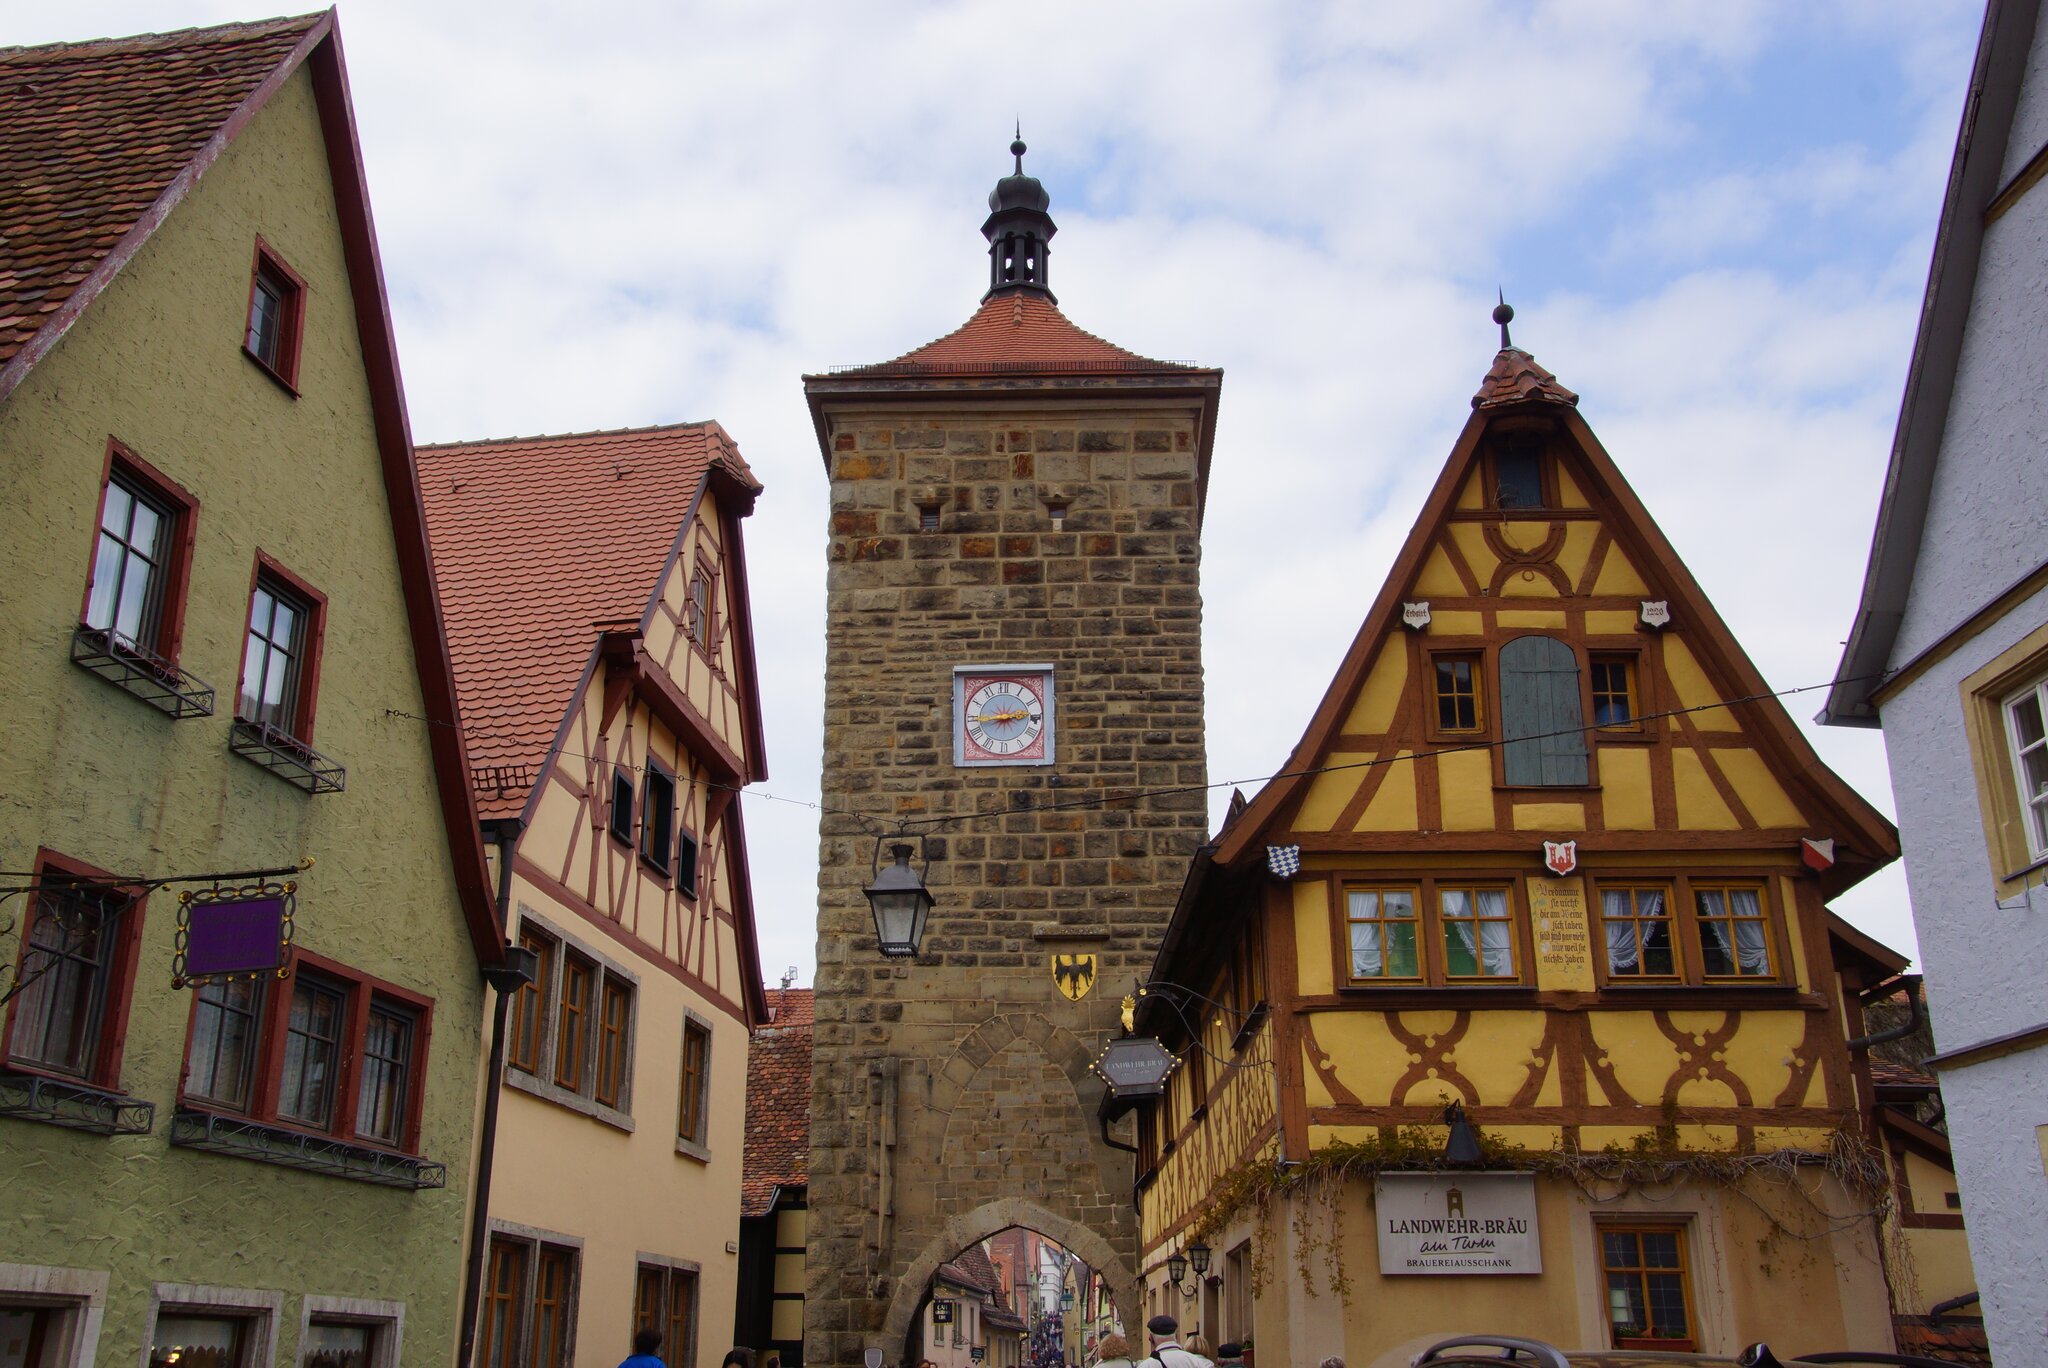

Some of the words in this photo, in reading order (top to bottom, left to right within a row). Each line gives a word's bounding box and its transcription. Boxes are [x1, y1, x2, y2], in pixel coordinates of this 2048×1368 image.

[1646, 608, 1663, 616] 1220
[998, 683, 1009, 693] XII
[1389, 1217, 1527, 1234] LANDWEHR-BRÄU
[1420, 1241, 1448, 1253] am
[1451, 1236, 1496, 1249] Turm
[1406, 1259, 1512, 1267] BRAUEREIAUSSCHANK
